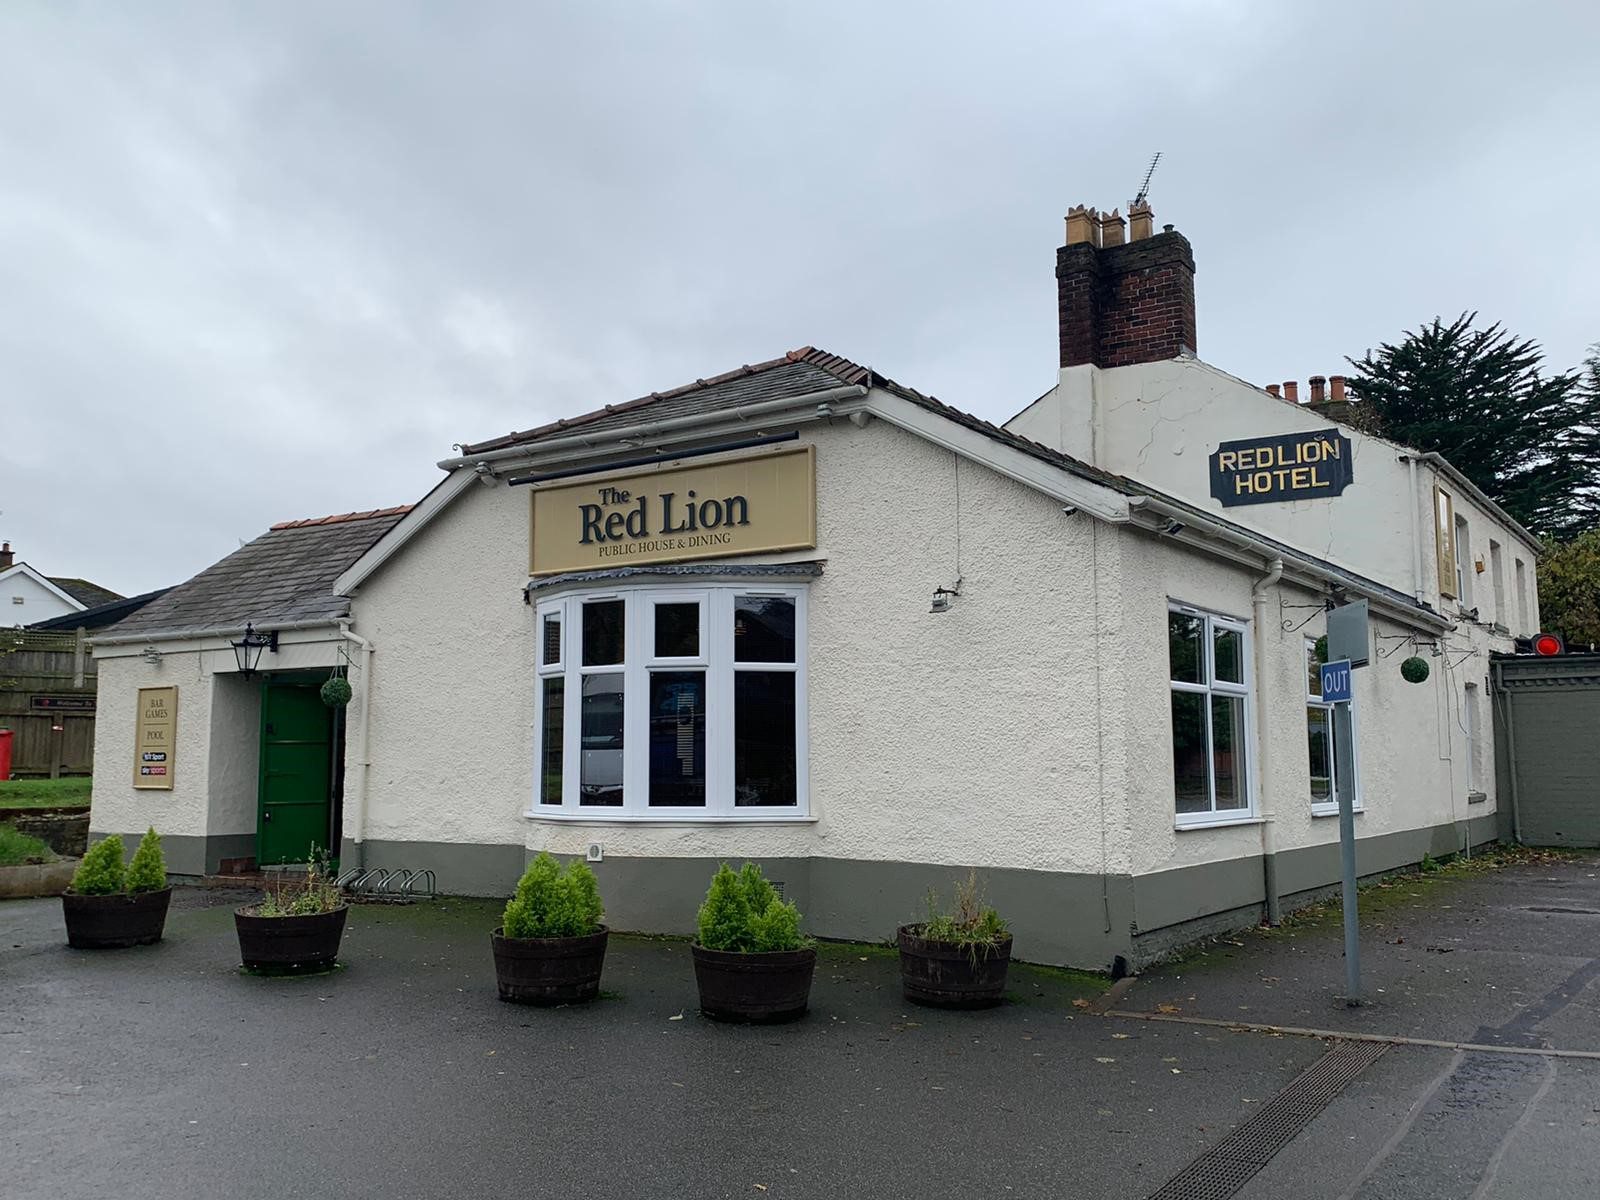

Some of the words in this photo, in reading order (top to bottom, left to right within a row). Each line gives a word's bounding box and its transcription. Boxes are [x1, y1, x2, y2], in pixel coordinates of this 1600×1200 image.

[1219, 447, 1274, 472] RED
[1277, 438, 1340, 466] LION
[1235, 466, 1330, 495] HOTEL
[599, 486, 631, 506] The
[578, 496, 649, 544] Red
[659, 490, 750, 534] Lion
[599, 543, 637, 557] PUBLIC
[638, 539, 675, 553] HOUSE
[677, 539, 686, 549] &
[688, 532, 732, 548] DINING
[1324, 670, 1348, 693] OUT
[145, 709, 168, 718] GAMES
[150, 699, 164, 708] BAR
[147, 730, 165, 740] POOL
